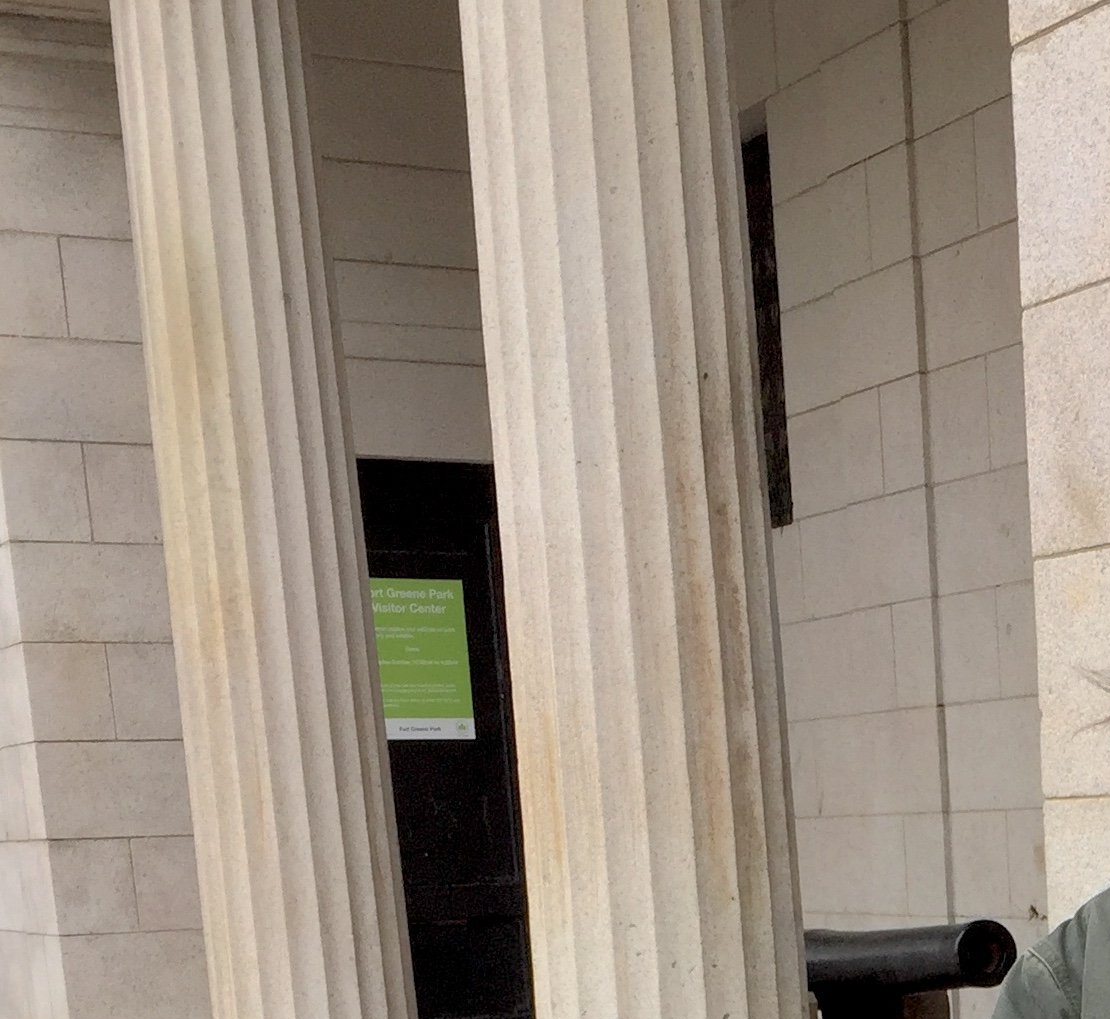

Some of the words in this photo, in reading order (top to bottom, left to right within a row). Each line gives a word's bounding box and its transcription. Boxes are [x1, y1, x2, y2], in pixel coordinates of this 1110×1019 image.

[371, 589, 383, 599] ort
[387, 588, 425, 599] Greene
[429, 588, 454, 600] Park
[410, 603, 447, 614] Center
